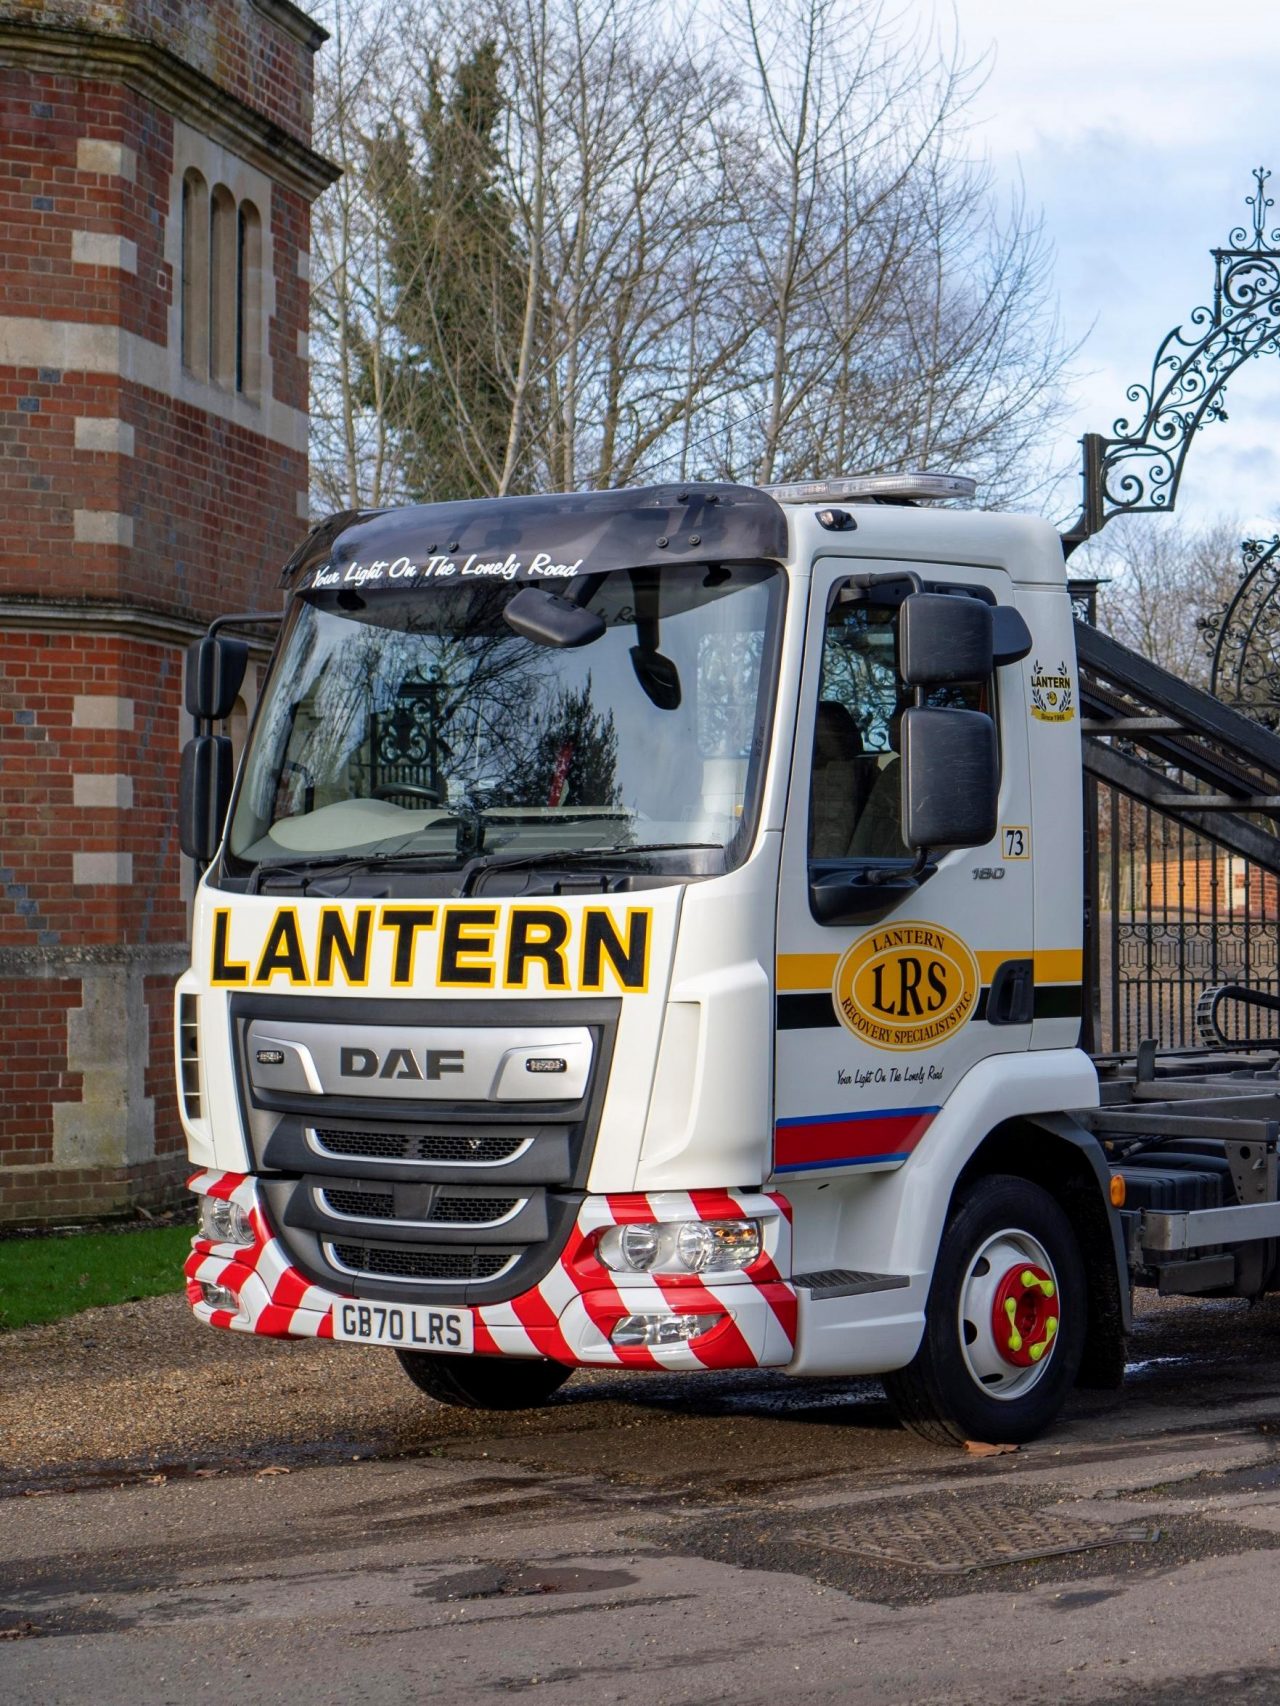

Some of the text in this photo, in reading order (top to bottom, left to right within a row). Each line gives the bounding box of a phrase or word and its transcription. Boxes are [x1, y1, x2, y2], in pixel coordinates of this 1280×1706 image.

[312, 553, 583, 588] Your Light On The Lonely Road
[1031, 675, 1071, 689] LANTERN
[1006, 830, 1024, 856] 73
[972, 867, 1005, 880] 180
[209, 904, 654, 993] LANTERN
[872, 929, 945, 952] LANTERN
[872, 957, 947, 1017] LRS
[841, 991, 972, 1044] RECOVERY SPECIALISTS PLC
[340, 1047, 464, 1080] DAF
[837, 1065, 945, 1088] Your Light On The Lonely Road
[342, 1304, 462, 1346] GB70 LRS
